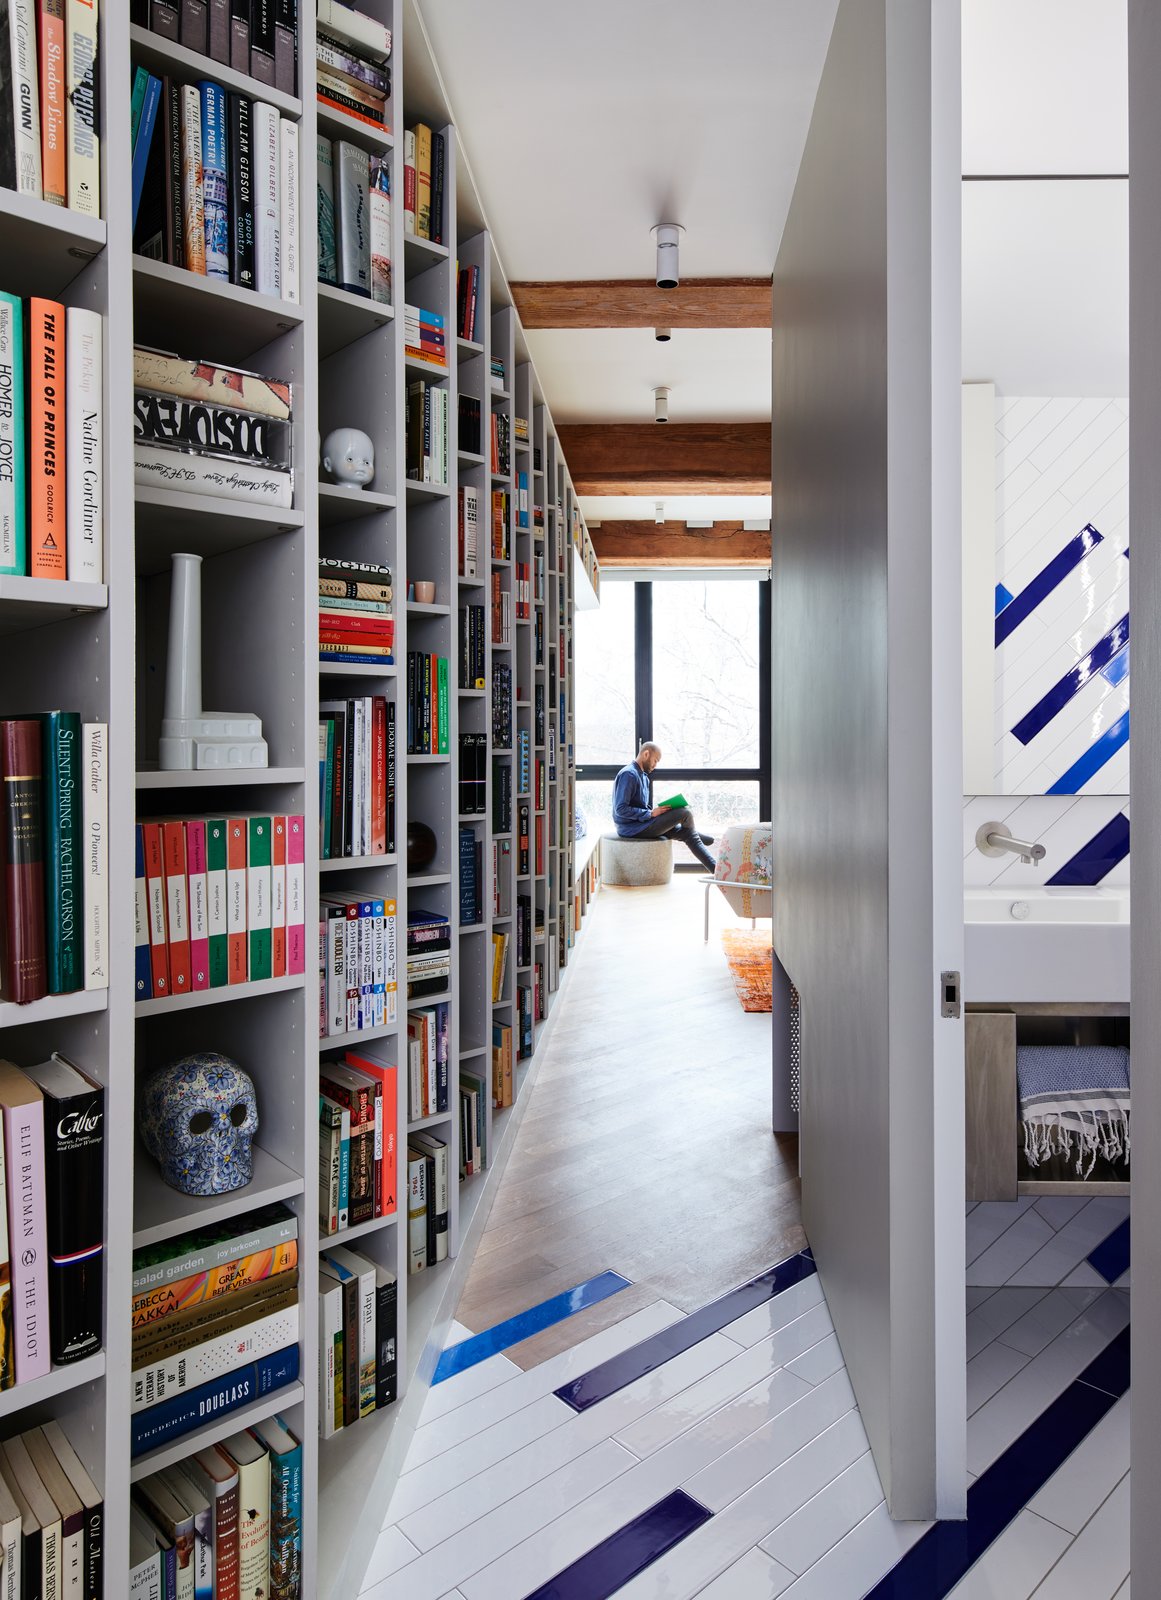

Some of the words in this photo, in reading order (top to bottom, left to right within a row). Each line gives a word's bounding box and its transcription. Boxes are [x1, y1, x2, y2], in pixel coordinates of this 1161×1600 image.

[73, 32, 94, 86] GEORGE
[321, 48, 334, 59] THE
[47, 42, 61, 103] Shadow
[20, 83, 33, 130] GUNN
[207, 87, 215, 126] GERMAN
[327, 90, 359, 109] CHOSEN
[47, 105, 62, 150] Lines
[239, 100, 249, 153] WILLIAM
[268, 113, 276, 162] ELIZABETH
[208, 129, 216, 165] POETRY
[240, 157, 249, 203] GIBSON
[287, 161, 295, 212] INCONVENIENT
[44, 313, 55, 342] THE
[82, 334, 93, 352] The
[44, 346, 55, 379] FALL
[79, 356, 94, 393] Pickup
[0, 363, 12, 419] HOMER
[44, 386, 55, 407] OF
[44, 411, 55, 477] PRINCES
[83, 409, 98, 464] Nadine
[0, 436, 13, 482] JOYCE
[46, 484, 54, 523] GOOLRICK
[83, 470, 98, 544] Gordimer
[58, 729, 73, 777] SILENT
[91, 730, 102, 758] Willa
[91, 760, 101, 794] Cather
[59, 778, 74, 829] SPRING
[60, 837, 73, 888] RACHEL
[91, 834, 101, 876] Pioneers!
[61, 889, 73, 941] CARSON
[334, 922, 343, 936] RICE
[334, 936, 343, 960] NOODLE
[334, 961, 343, 976] FISH
[57, 1100, 103, 1139] Cather
[359, 1093, 368, 1124] SHOWA
[20, 1125, 31, 1157] ELIF
[375, 1131, 383, 1158] TOKYO
[386, 1132, 395, 1153] Tokyo
[21, 1164, 34, 1238] BATUMAN
[331, 1183, 339, 1209] HANDBOOK
[133, 1268, 164, 1287] salad
[166, 1256, 204, 1280] garden
[217, 1249, 229, 1259] joy
[230, 1238, 260, 1253] larkcom
[218, 1268, 246, 1285] GREAT
[226, 1263, 237, 1271] THE
[25, 1277, 36, 1309] THE
[212, 1276, 252, 1297] BELIEVERS
[363, 1291, 374, 1324] Japan
[26, 1314, 38, 1359] IDIOT
[135, 1380, 143, 1396] NEW
[146, 1371, 154, 1404] LITERARY
[157, 1368, 165, 1397] HISTORY
[168, 1374, 175, 1383] OF
[178, 1358, 187, 1388] AMERICA
[137, 1410, 196, 1441] FREDERICK
[199, 1381, 250, 1417] DOUGLASS
[282, 1480, 290, 1517] Occasions
[89, 1515, 100, 1538] Old
[240, 1520, 255, 1529] The
[8, 1540, 17, 1572] Thomas
[46, 1533, 56, 1574] THOMAS
[90, 1543, 100, 1589] Masters
[282, 1540, 290, 1574] Sullivan
[133, 1563, 156, 1581] PETER
